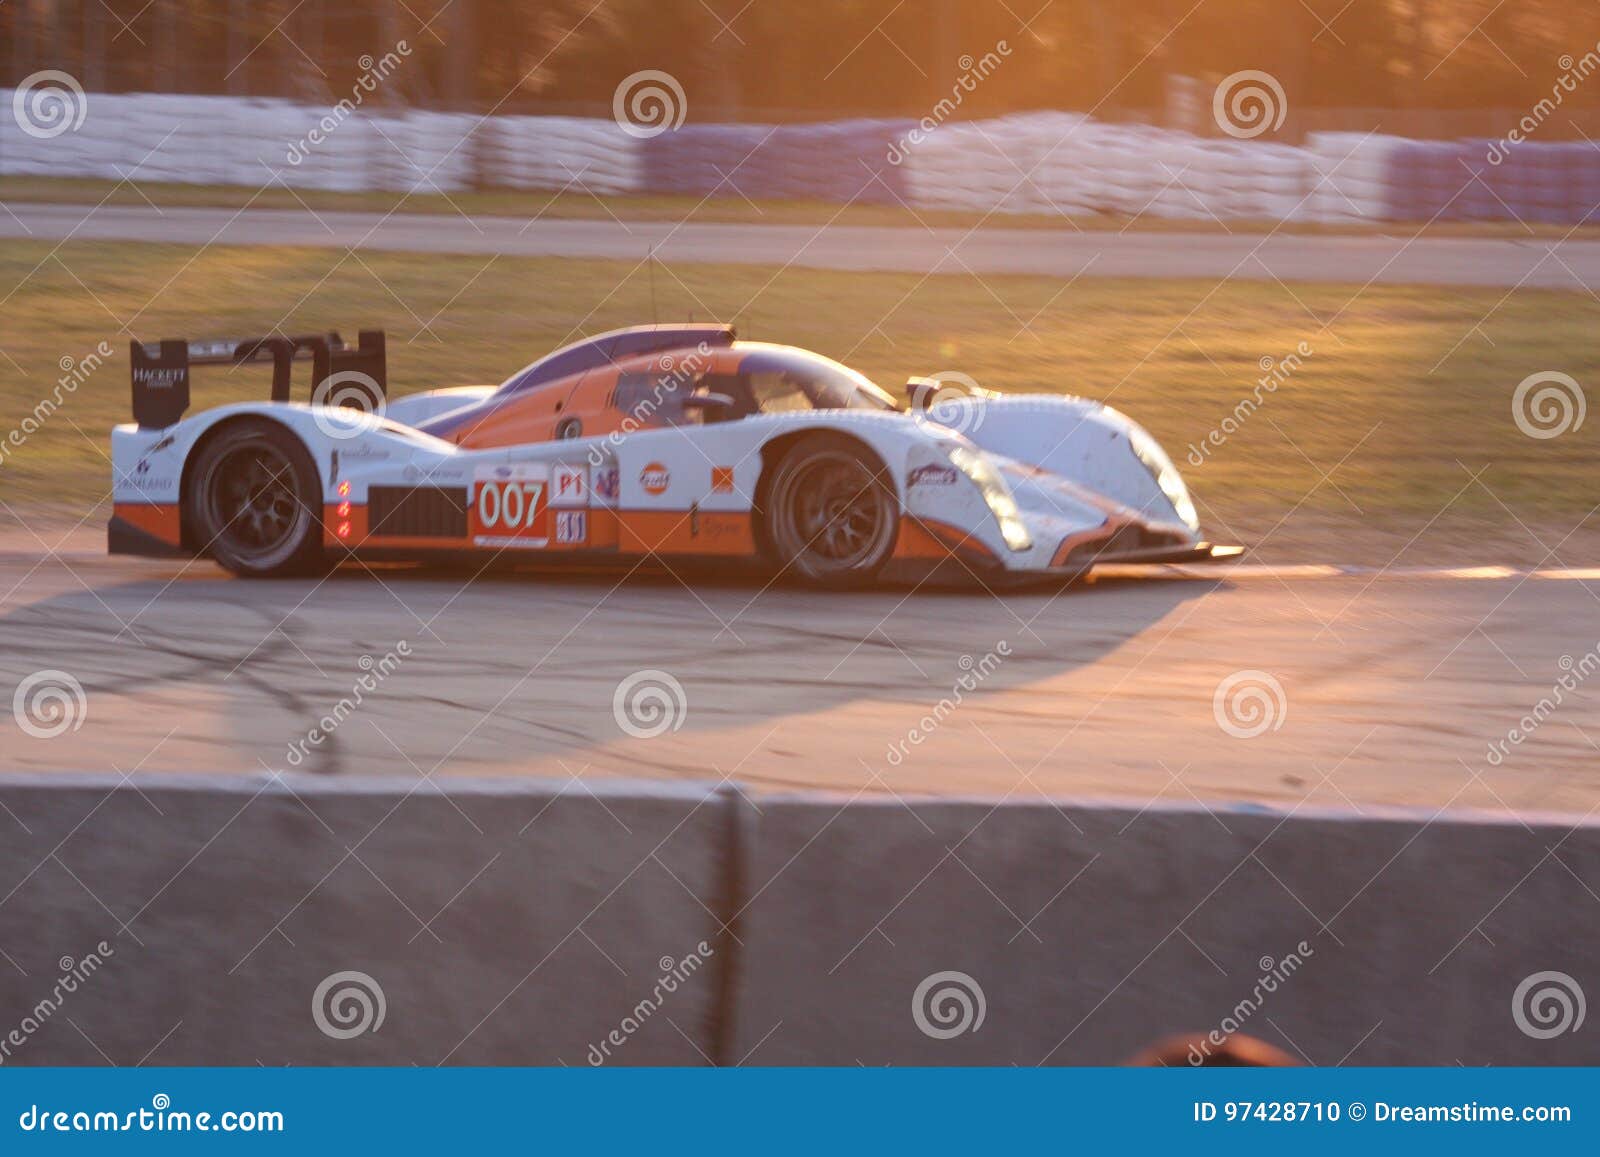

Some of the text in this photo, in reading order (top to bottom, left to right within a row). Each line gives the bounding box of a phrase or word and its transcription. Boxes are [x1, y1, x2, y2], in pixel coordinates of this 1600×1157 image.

[134, 367, 184, 381] HACKETT
[560, 473, 582, 494] P1
[479, 482, 542, 528] 007
